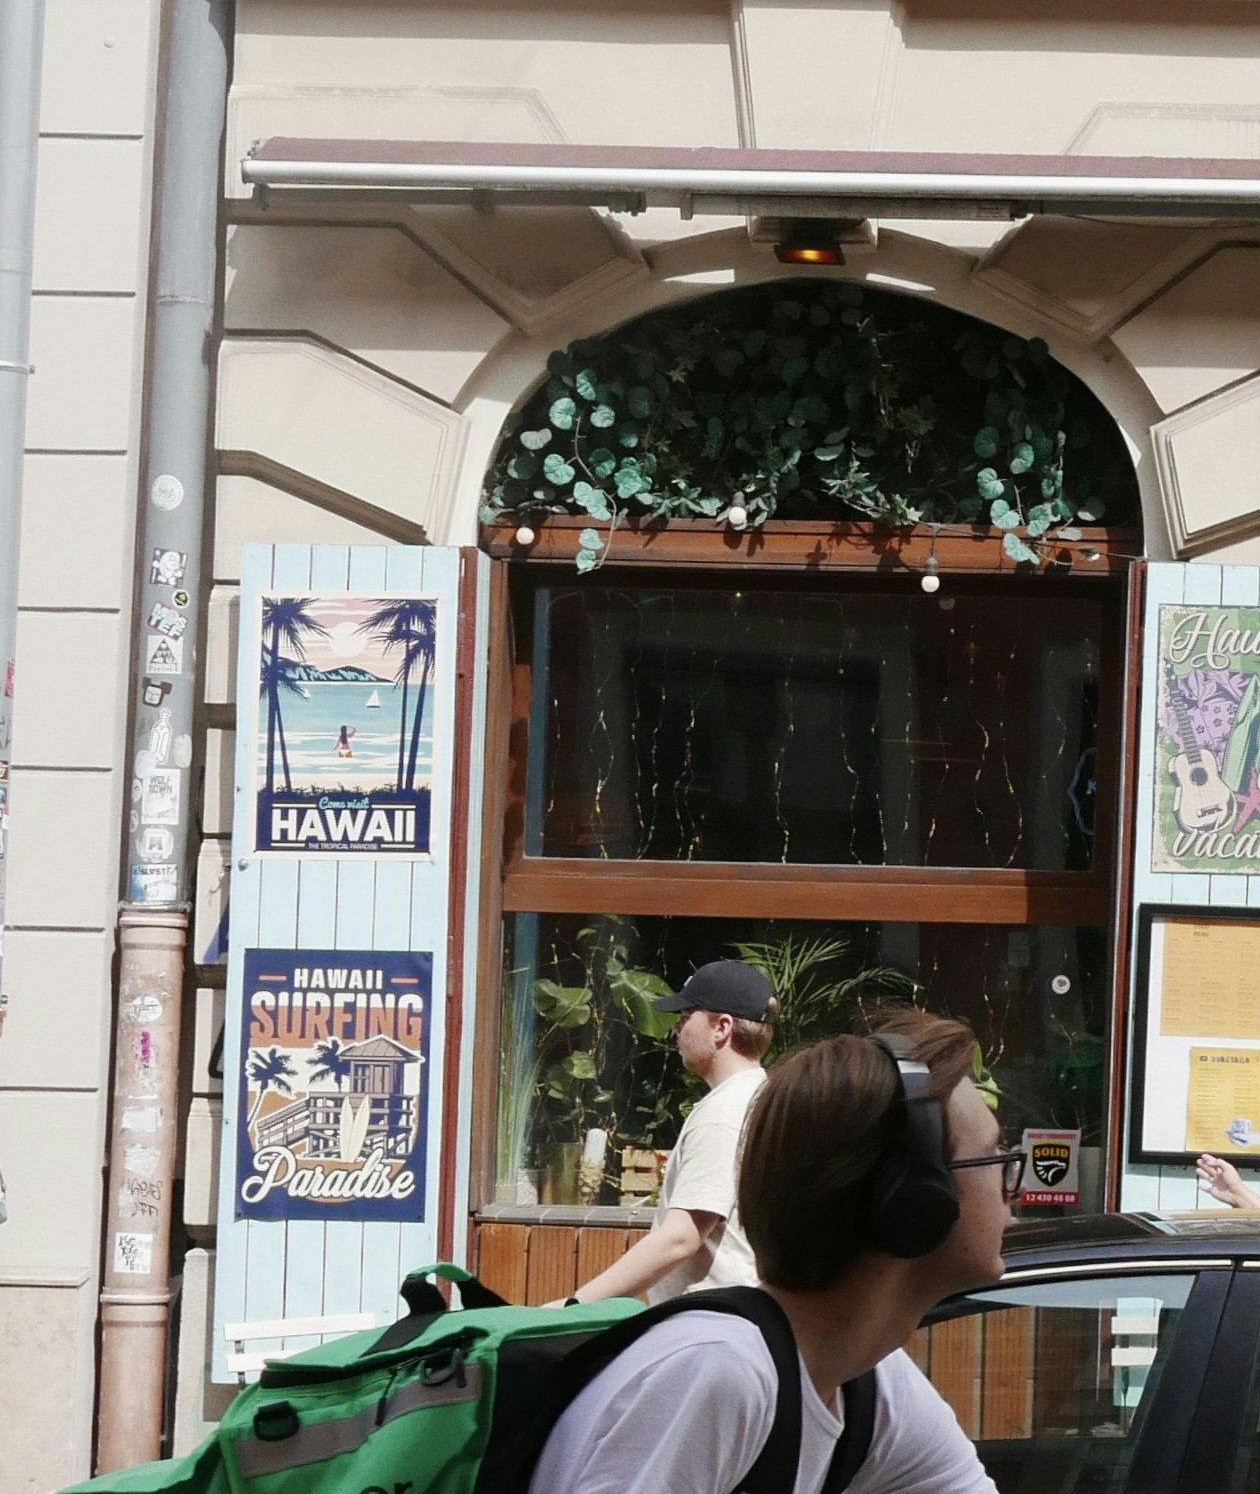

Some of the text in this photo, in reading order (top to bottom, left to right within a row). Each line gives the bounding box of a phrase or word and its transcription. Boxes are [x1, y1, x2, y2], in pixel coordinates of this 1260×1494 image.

[319, 796, 369, 809] Come visit
[271, 808, 416, 842] HAWAII
[308, 842, 319, 850] THE
[320, 842, 349, 850] TROPICAL
[294, 968, 383, 990] HAWAII
[250, 991, 424, 1042] SURFING
[1034, 1147, 1069, 1158] SOLID
[241, 1146, 416, 1204] Paradise
[1026, 1193, 1036, 1202] 12
